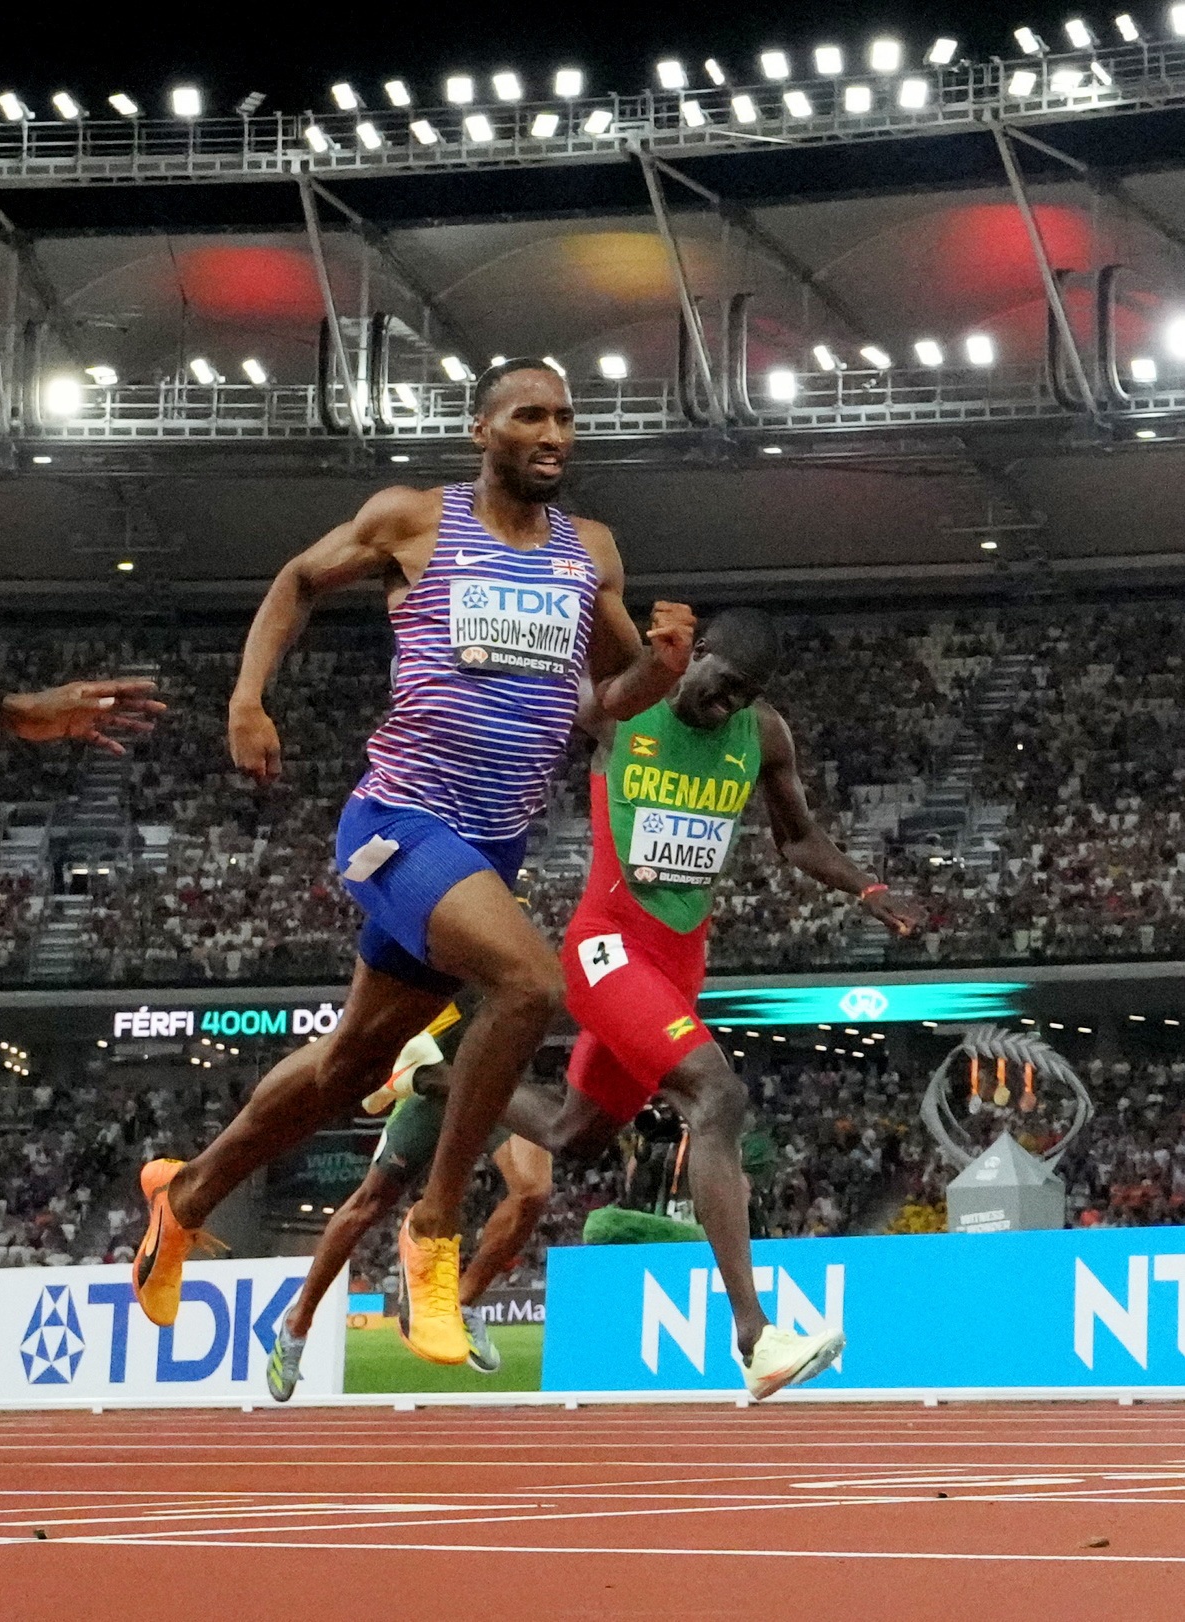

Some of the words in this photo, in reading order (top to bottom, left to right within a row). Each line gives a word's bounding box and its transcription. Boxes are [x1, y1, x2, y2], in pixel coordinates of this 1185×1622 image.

[489, 585, 571, 619] TDK
[456, 617, 572, 655] HUDSON-SMITH
[491, 652, 552, 672] BUDAPEST
[666, 814, 728, 842] TDK
[644, 840, 716, 870] JAMES
[592, 941, 610, 966] 4
[114, 1006, 195, 1038] FÉRFI
[201, 1010, 287, 1036] 400M
[292, 1003, 345, 1034] DÖ
[87, 1275, 308, 1384] TDK
